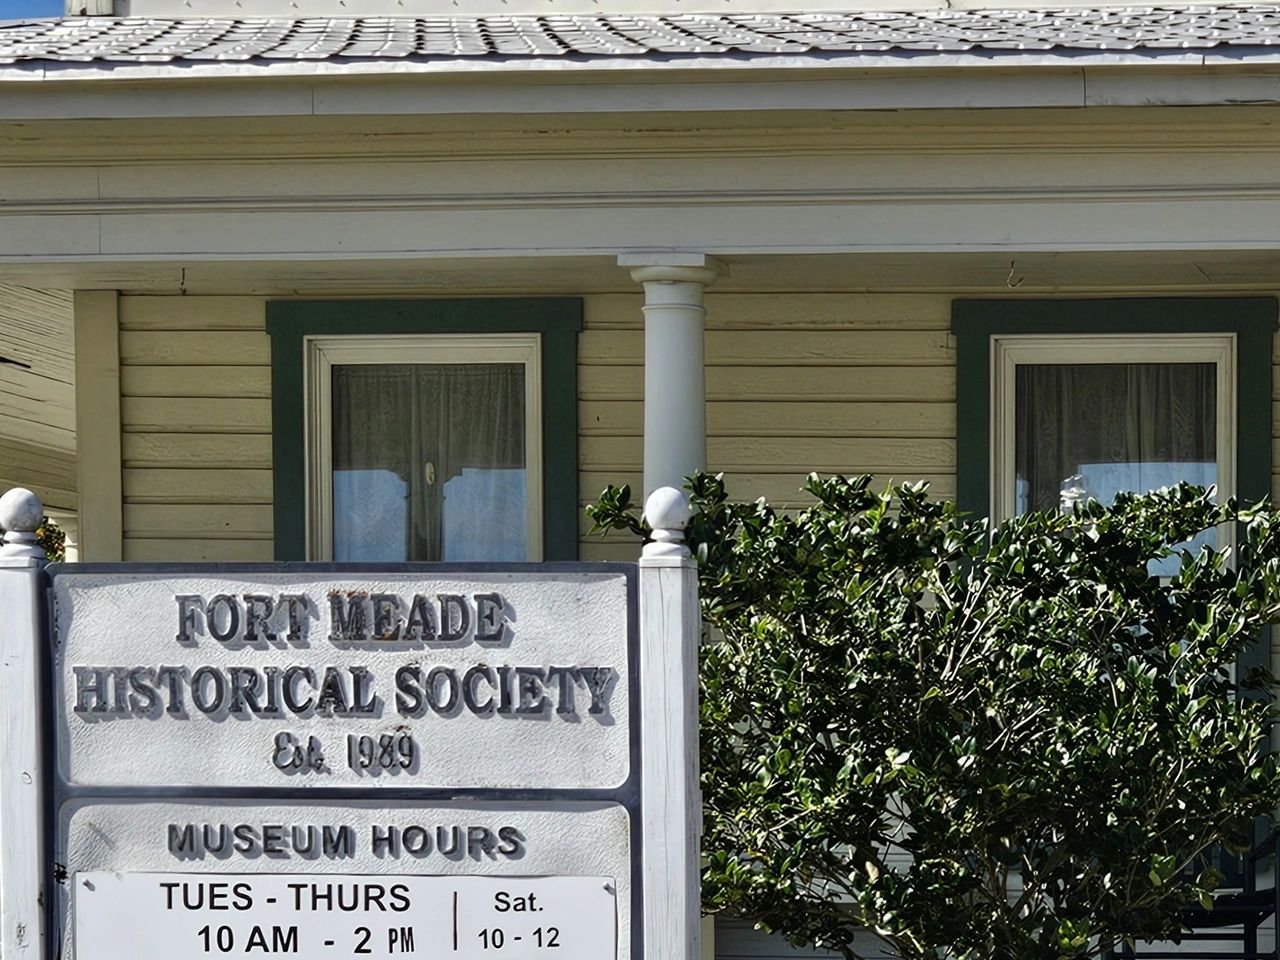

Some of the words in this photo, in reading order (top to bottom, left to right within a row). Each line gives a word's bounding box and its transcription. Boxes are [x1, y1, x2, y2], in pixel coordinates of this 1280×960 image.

[175, 593, 310, 643] FORT
[327, 593, 506, 643] MEADE
[73, 665, 379, 714] HISTORICAL
[395, 664, 617, 715] SOCIETY
[347, 732, 415, 770] 1989
[168, 824, 350, 856] MUSEUM
[372, 825, 524, 856] HOURS
[160, 882, 253, 910] TUES
[288, 883, 411, 912] THURS
[494, 891, 544, 912] Sat.
[197, 925, 234, 953] 10
[245, 925, 299, 953] AM
[353, 926, 372, 953] 2
[388, 926, 415, 953] PM
[478, 928, 504, 950] 10
[532, 926, 560, 948] 12
